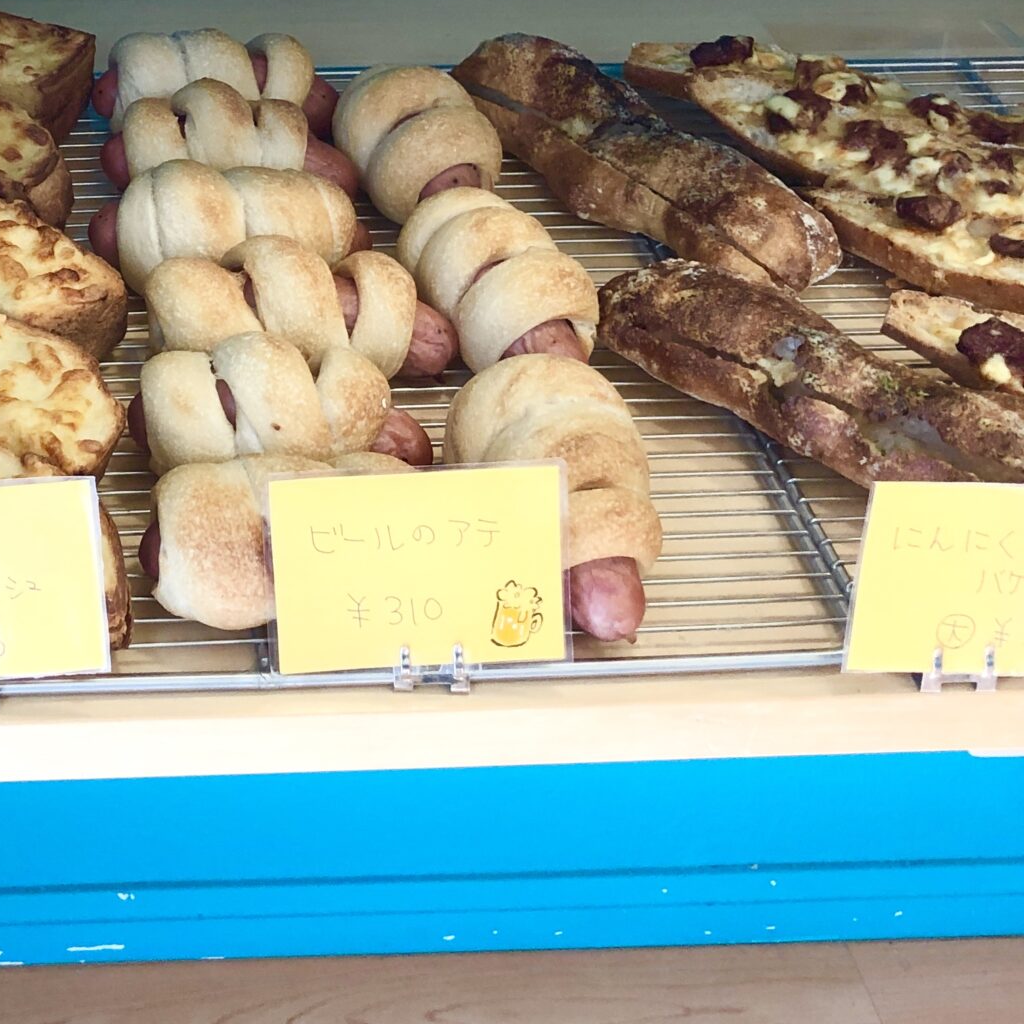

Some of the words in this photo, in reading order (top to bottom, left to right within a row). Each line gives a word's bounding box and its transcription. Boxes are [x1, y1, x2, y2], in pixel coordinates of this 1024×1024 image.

[310, 519, 500, 553] ビールのアテ
[893, 527, 1015, 559] にんにく
